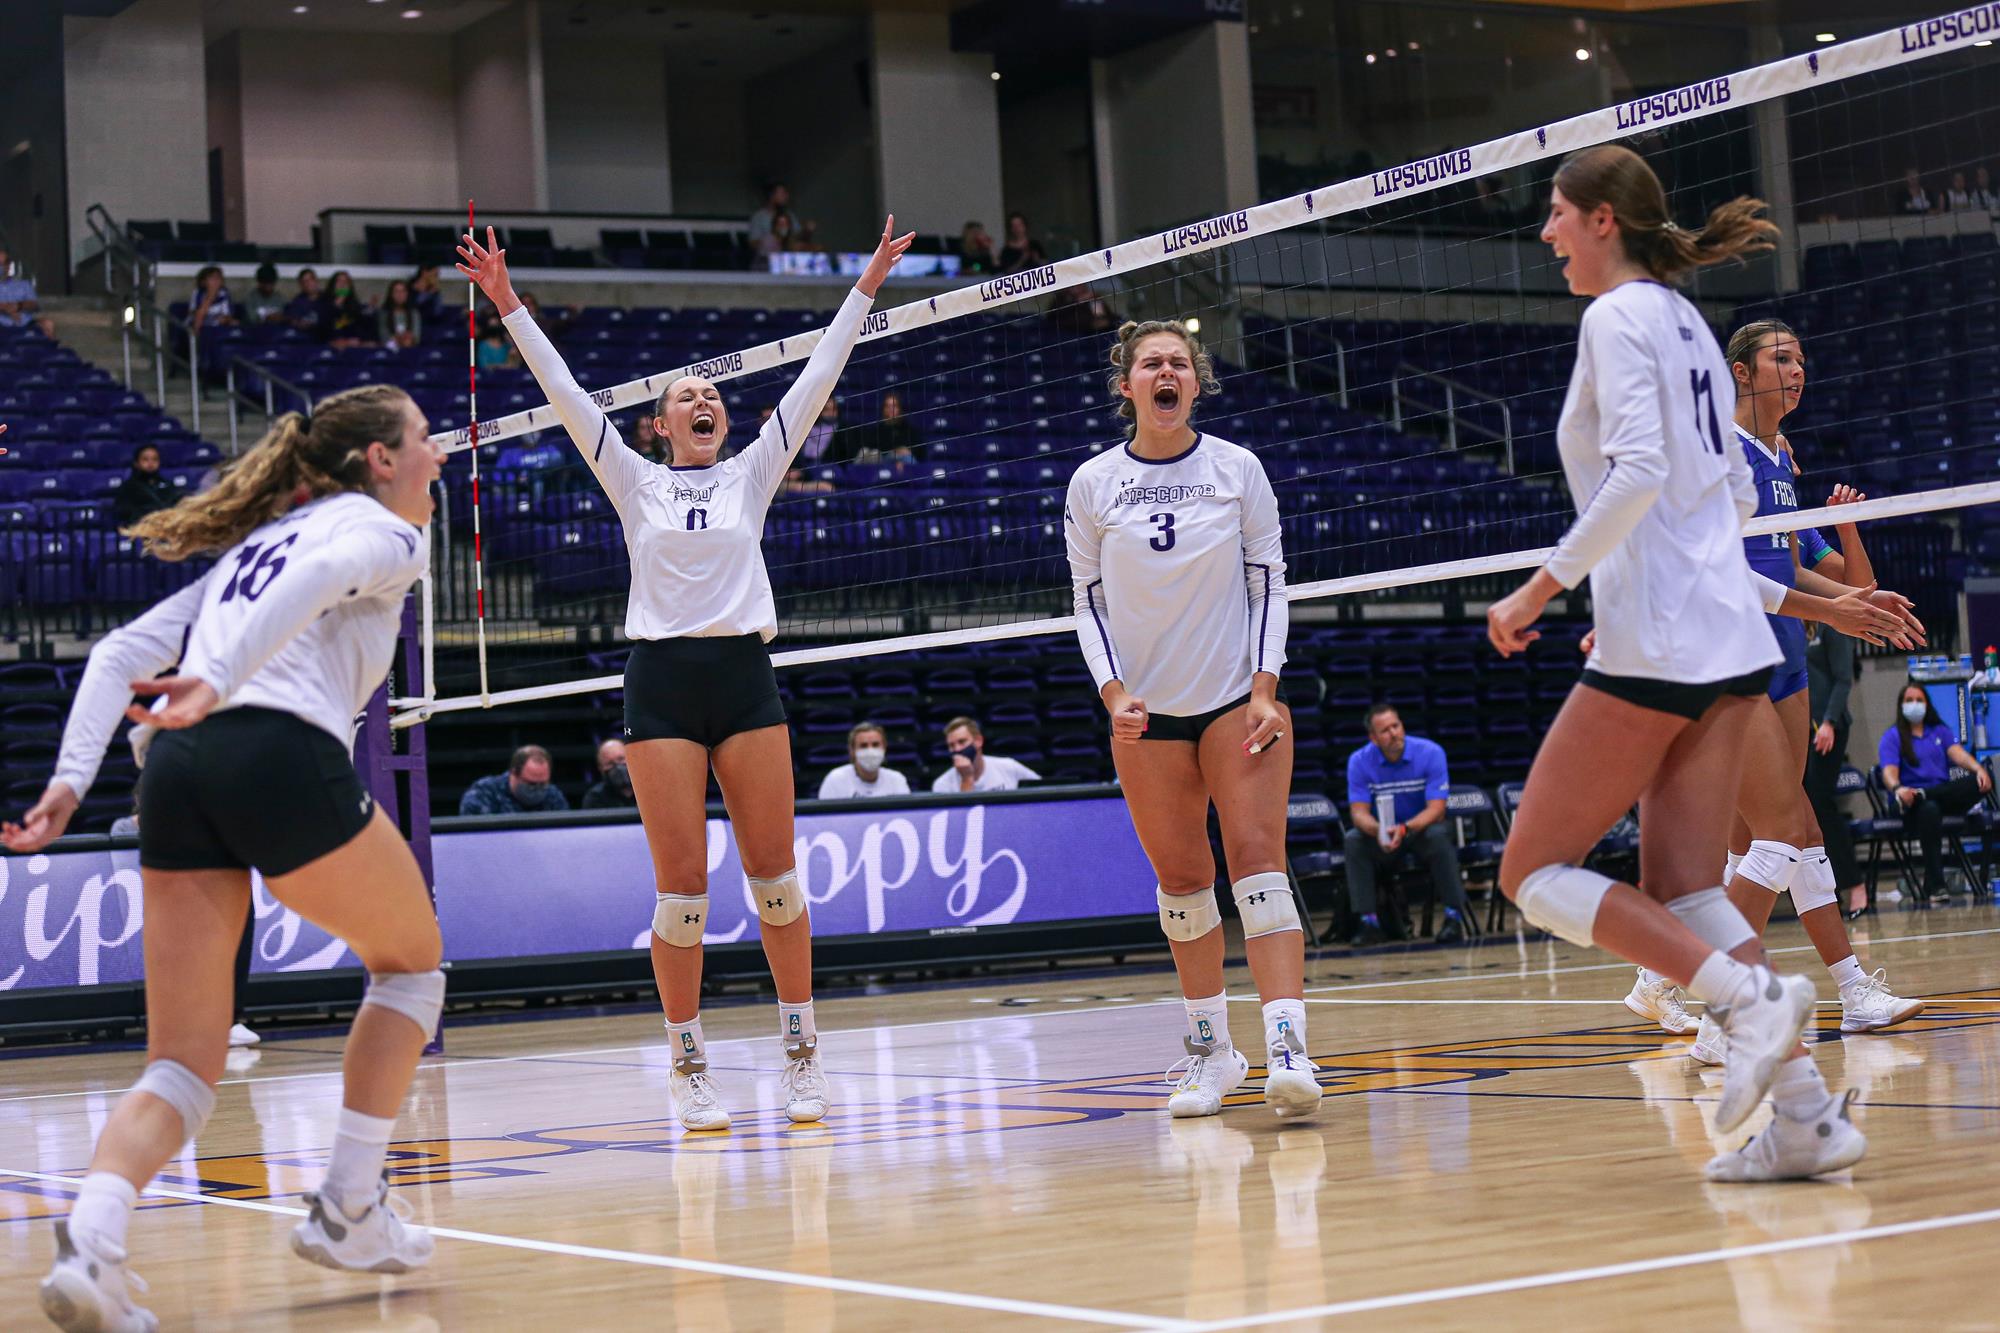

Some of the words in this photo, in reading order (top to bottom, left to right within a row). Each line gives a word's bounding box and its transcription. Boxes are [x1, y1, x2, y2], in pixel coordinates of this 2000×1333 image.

[1615, 76, 1731, 130] LIPSCOMB
[1372, 149, 1472, 197] LIPSCOMB
[1162, 210, 1249, 254] LIPSCOMB
[980, 265, 1056, 302] LIPSCOMB
[1114, 483, 1217, 508] LIPSCOMB
[1149, 512, 1177, 552] 3
[219, 532, 299, 604] 16
